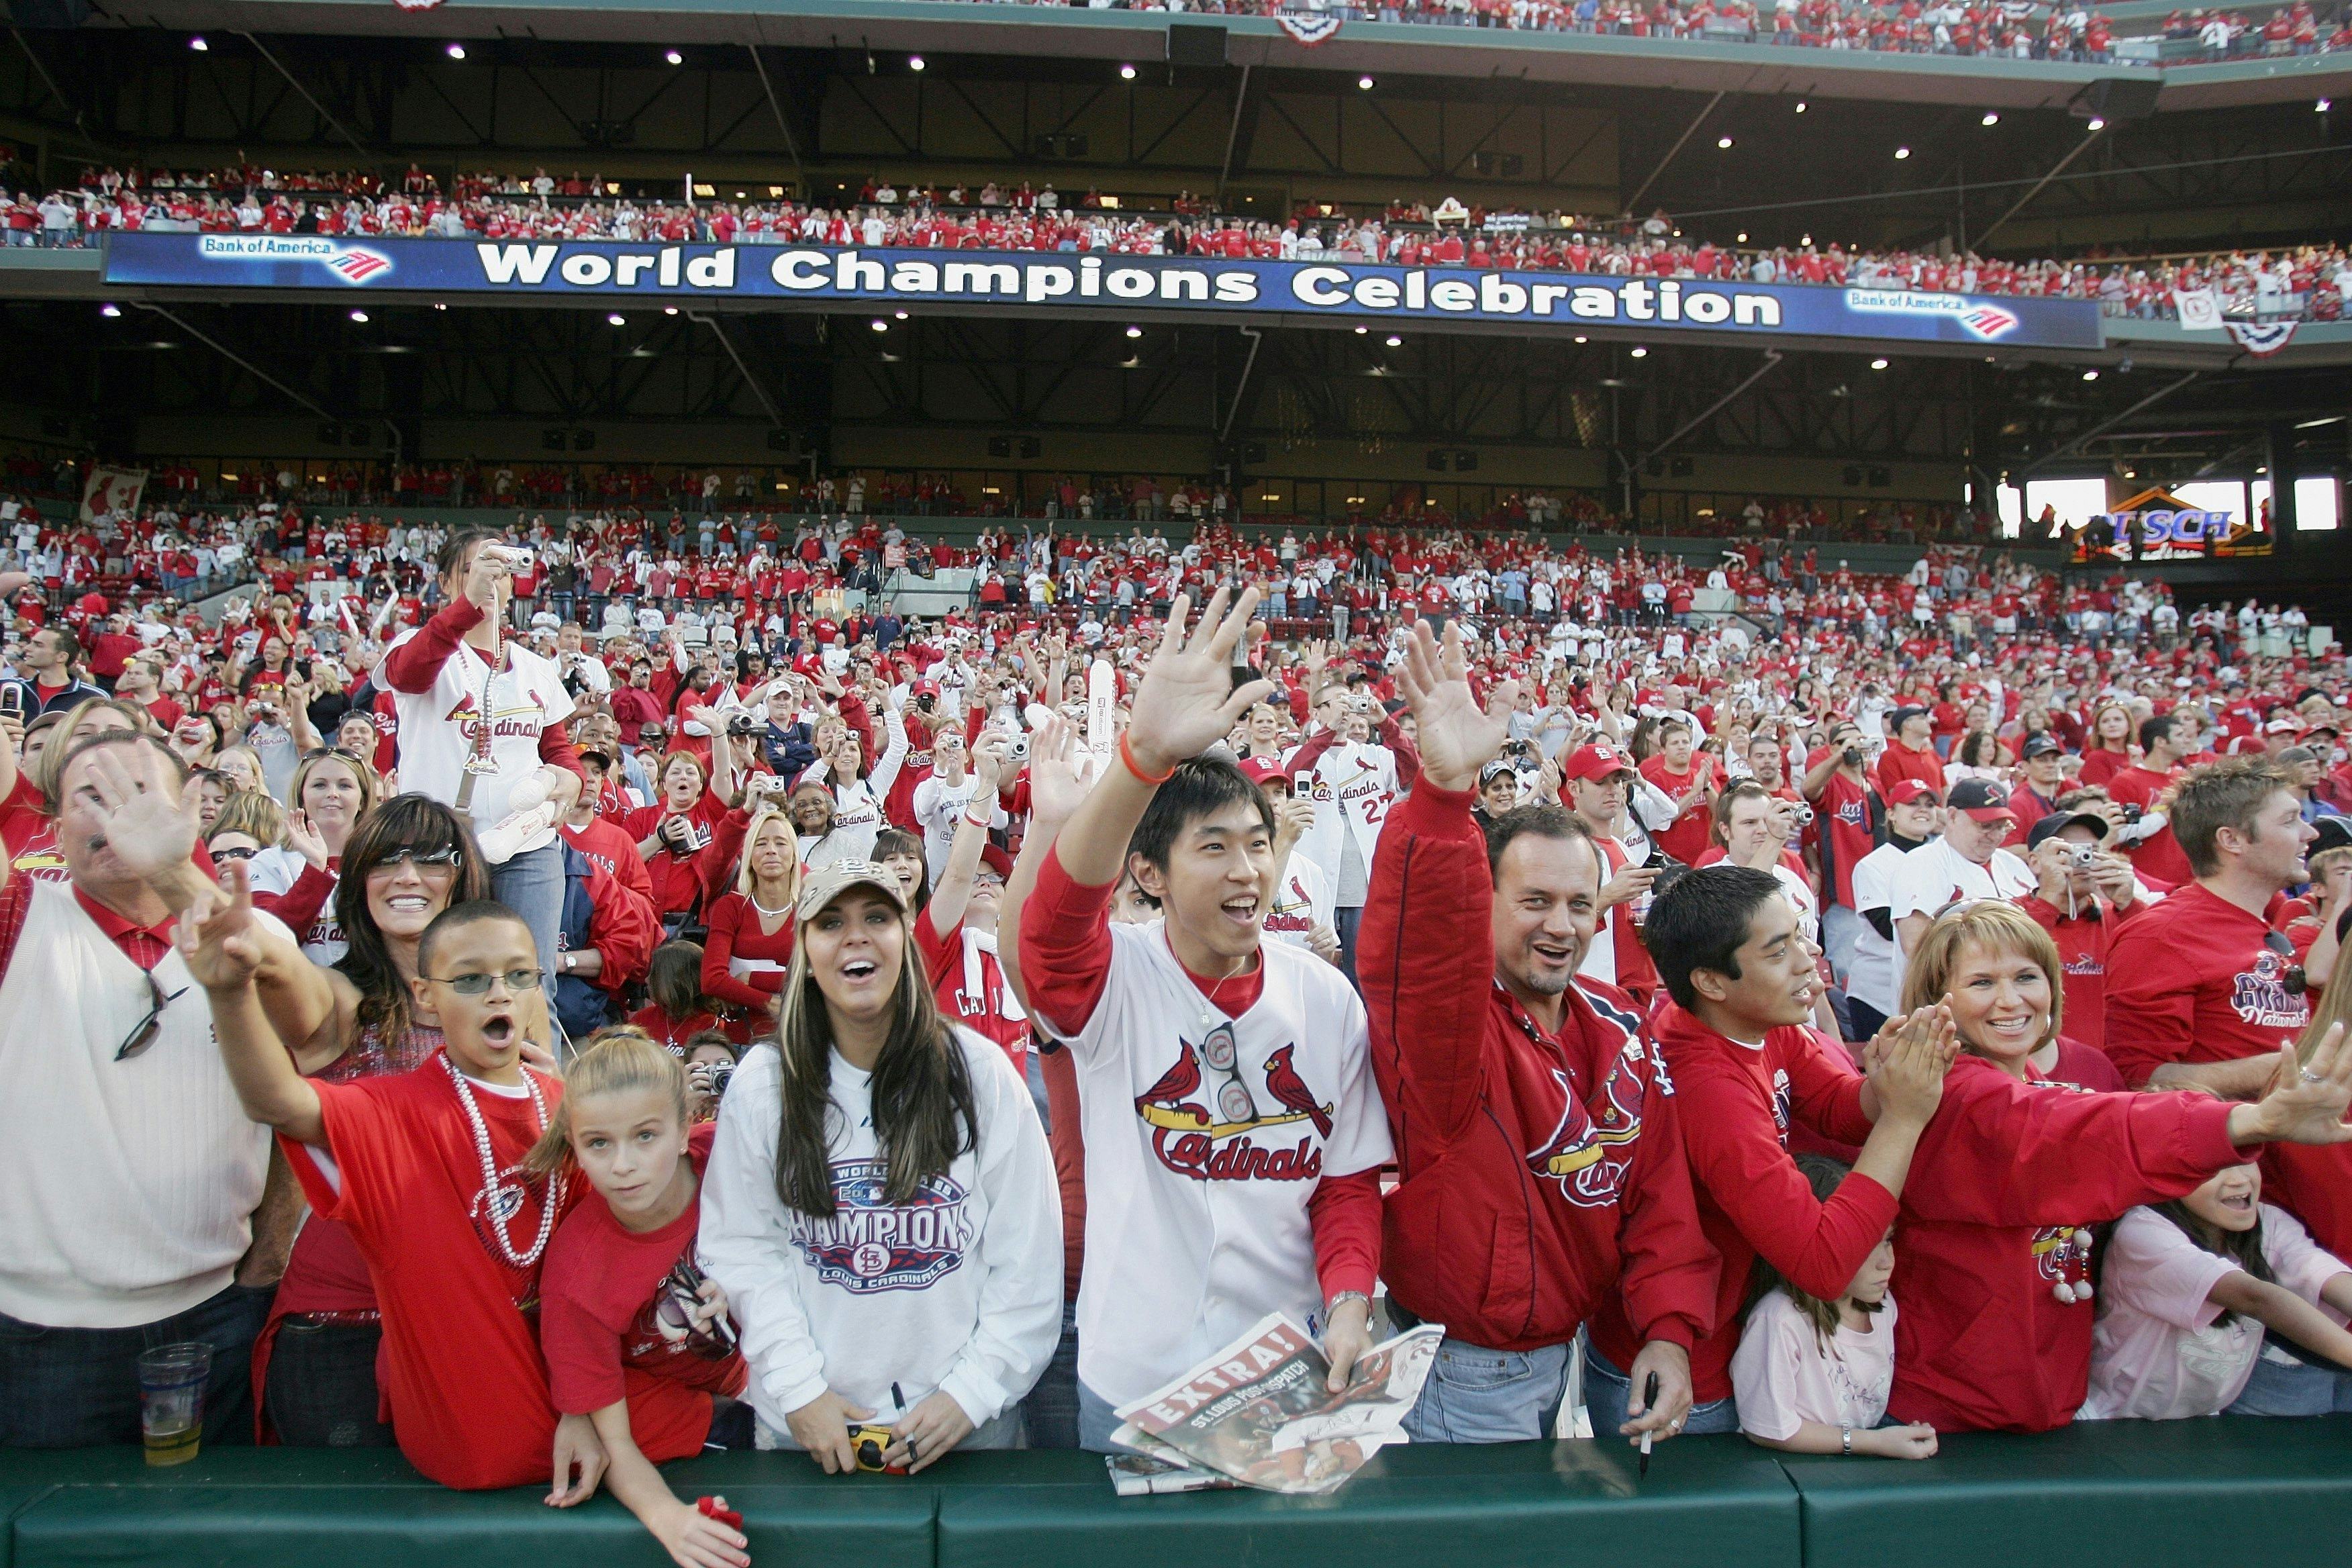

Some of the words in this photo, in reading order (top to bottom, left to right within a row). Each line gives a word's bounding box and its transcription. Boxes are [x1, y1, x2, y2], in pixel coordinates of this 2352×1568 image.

[205, 238, 244, 252] Bank
[248, 238, 262, 252] of
[266, 237, 331, 254] America
[477, 244, 735, 288] World
[772, 250, 1259, 302] Champions
[1291, 267, 1780, 326] Celebration
[1852, 292, 1884, 305] Bank
[1889, 293, 1902, 306] of
[1906, 295, 1964, 309] America
[1312, 780, 1380, 802] Cardinals
[1361, 791, 1395, 825] 27
[1152, 1126, 1323, 1181] Cardinals
[789, 1197, 974, 1252] HAMPIONS
[822, 1269, 863, 1289] LOUIS
[867, 1260, 948, 1288] CARDINALS
[1145, 1331, 1295, 1424] EXTRA!
[1235, 1359, 1310, 1402] POST-SPATCH
